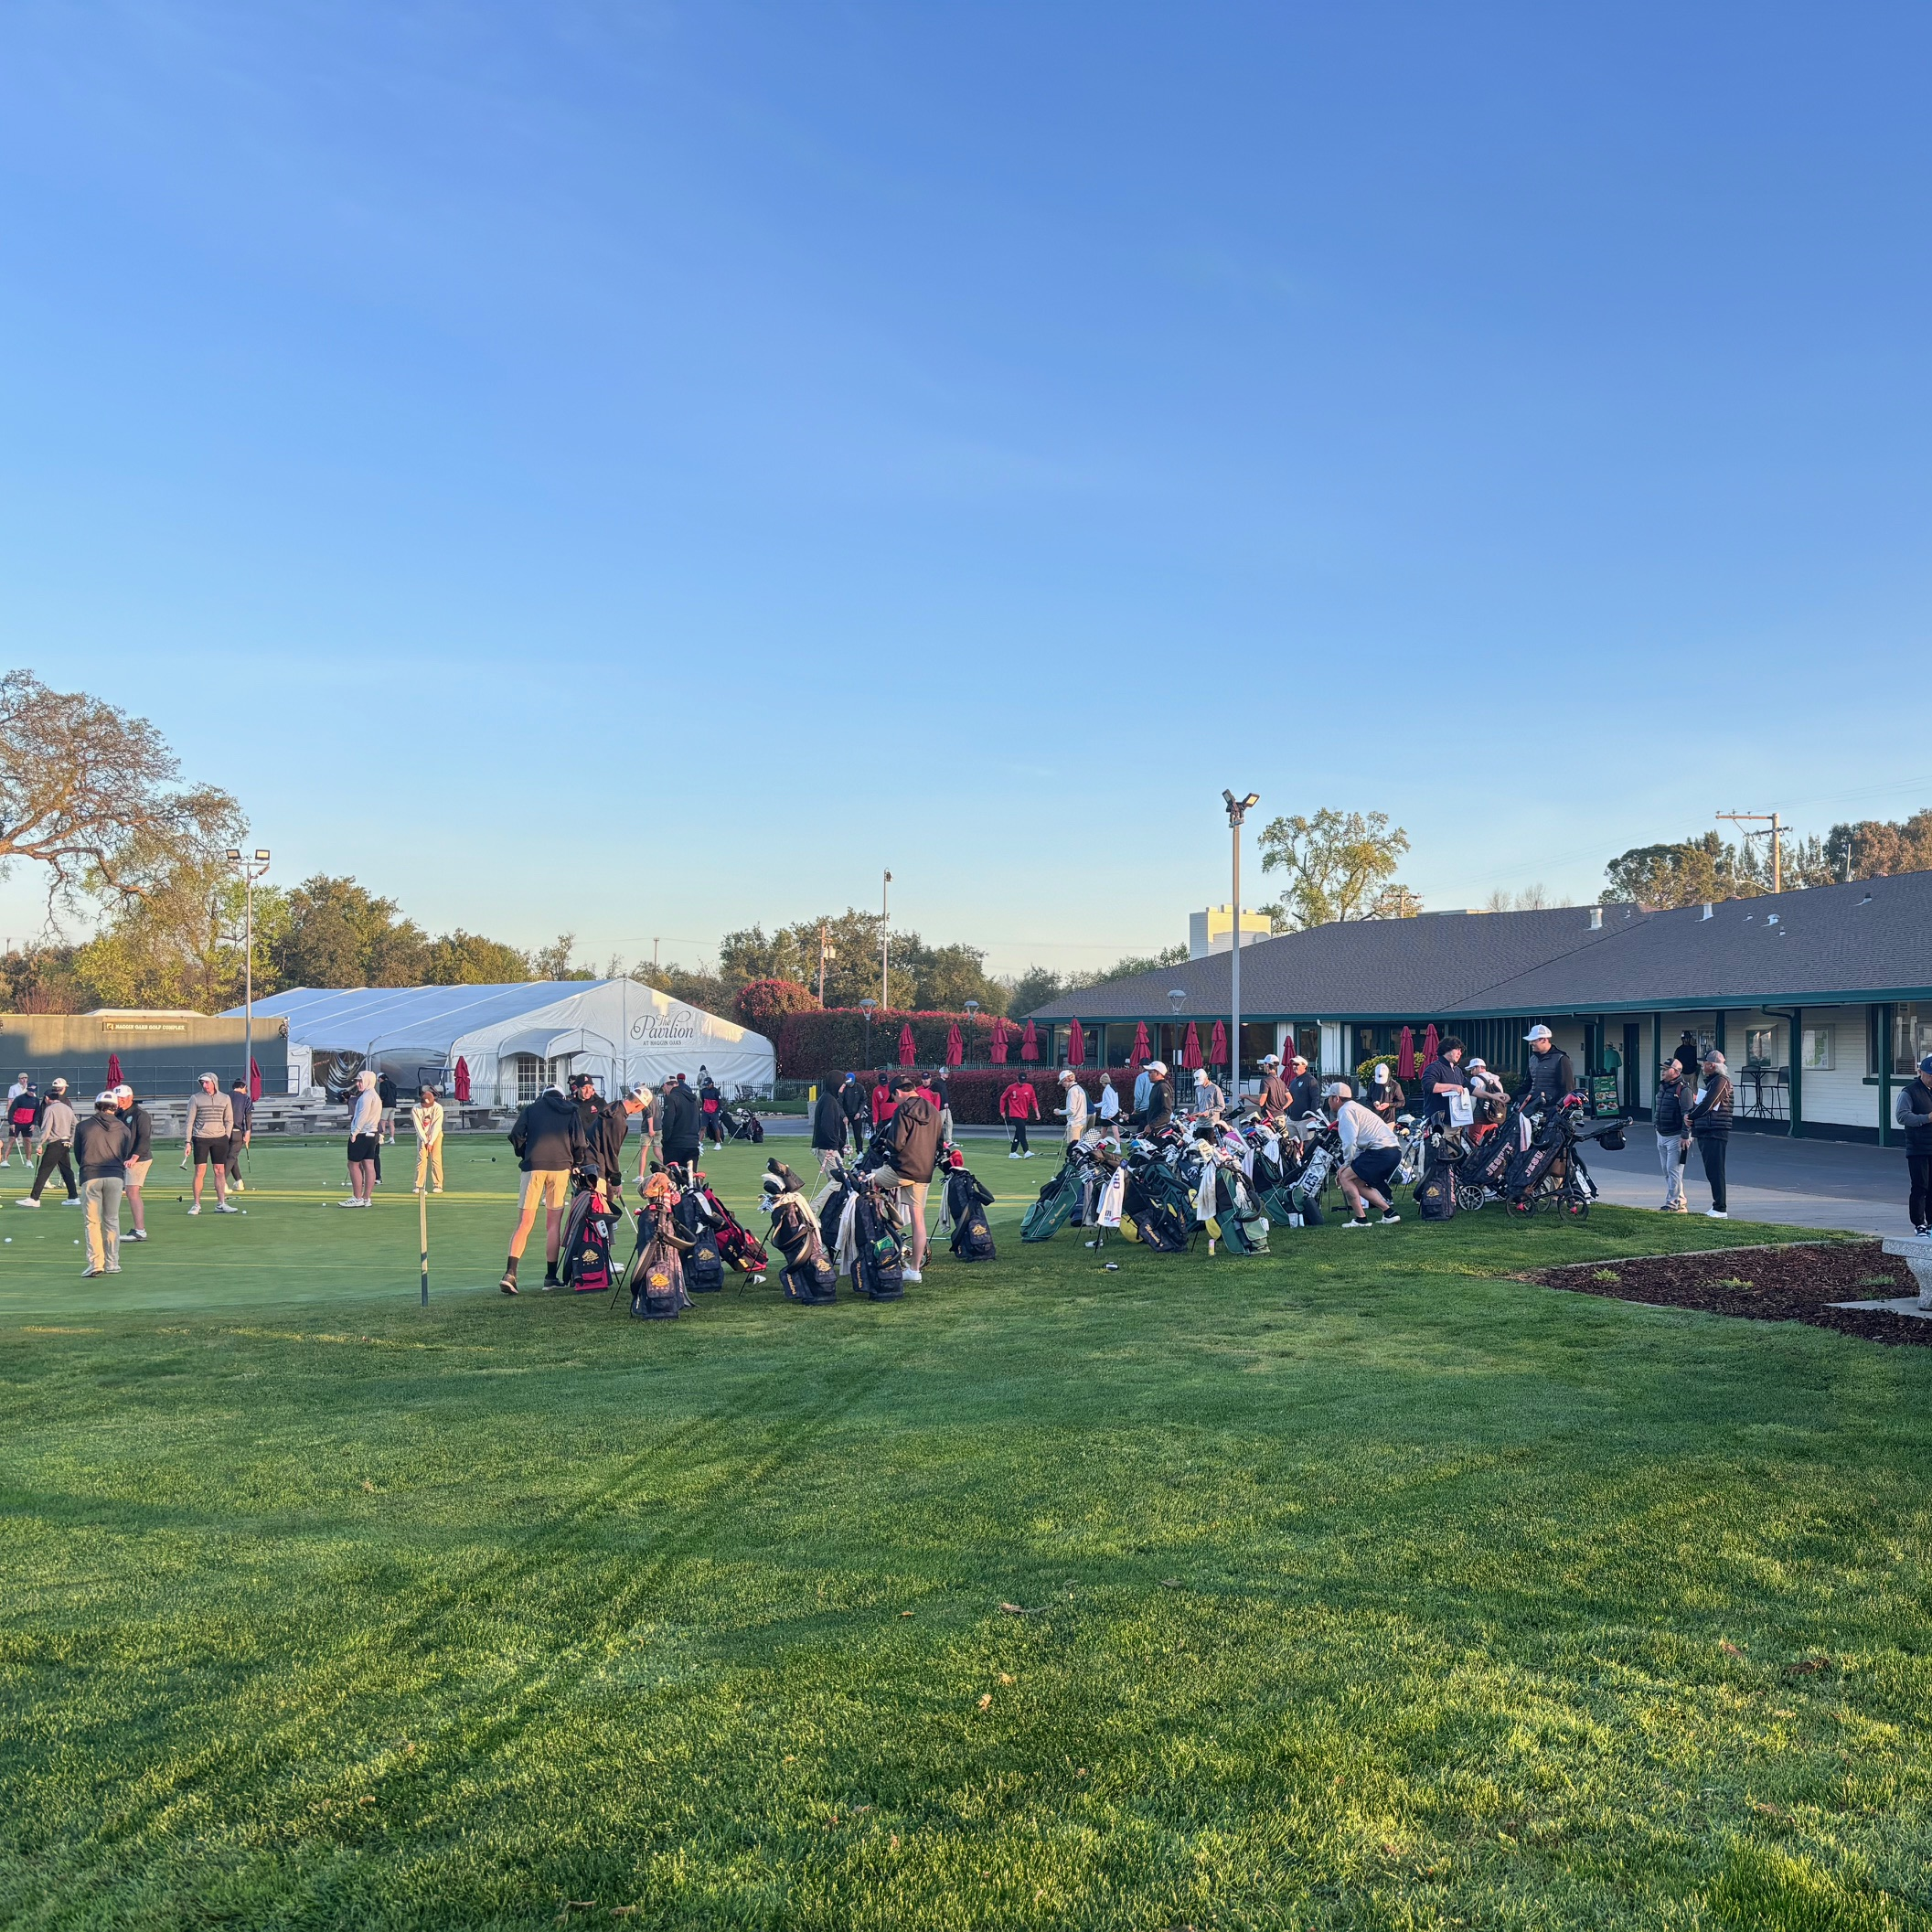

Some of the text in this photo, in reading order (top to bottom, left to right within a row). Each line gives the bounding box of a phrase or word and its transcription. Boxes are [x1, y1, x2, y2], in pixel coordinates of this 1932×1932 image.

[630, 1010, 693, 1040] Pavilion
[656, 1014, 671, 1026] The
[1303, 1172, 1319, 1195] LES
